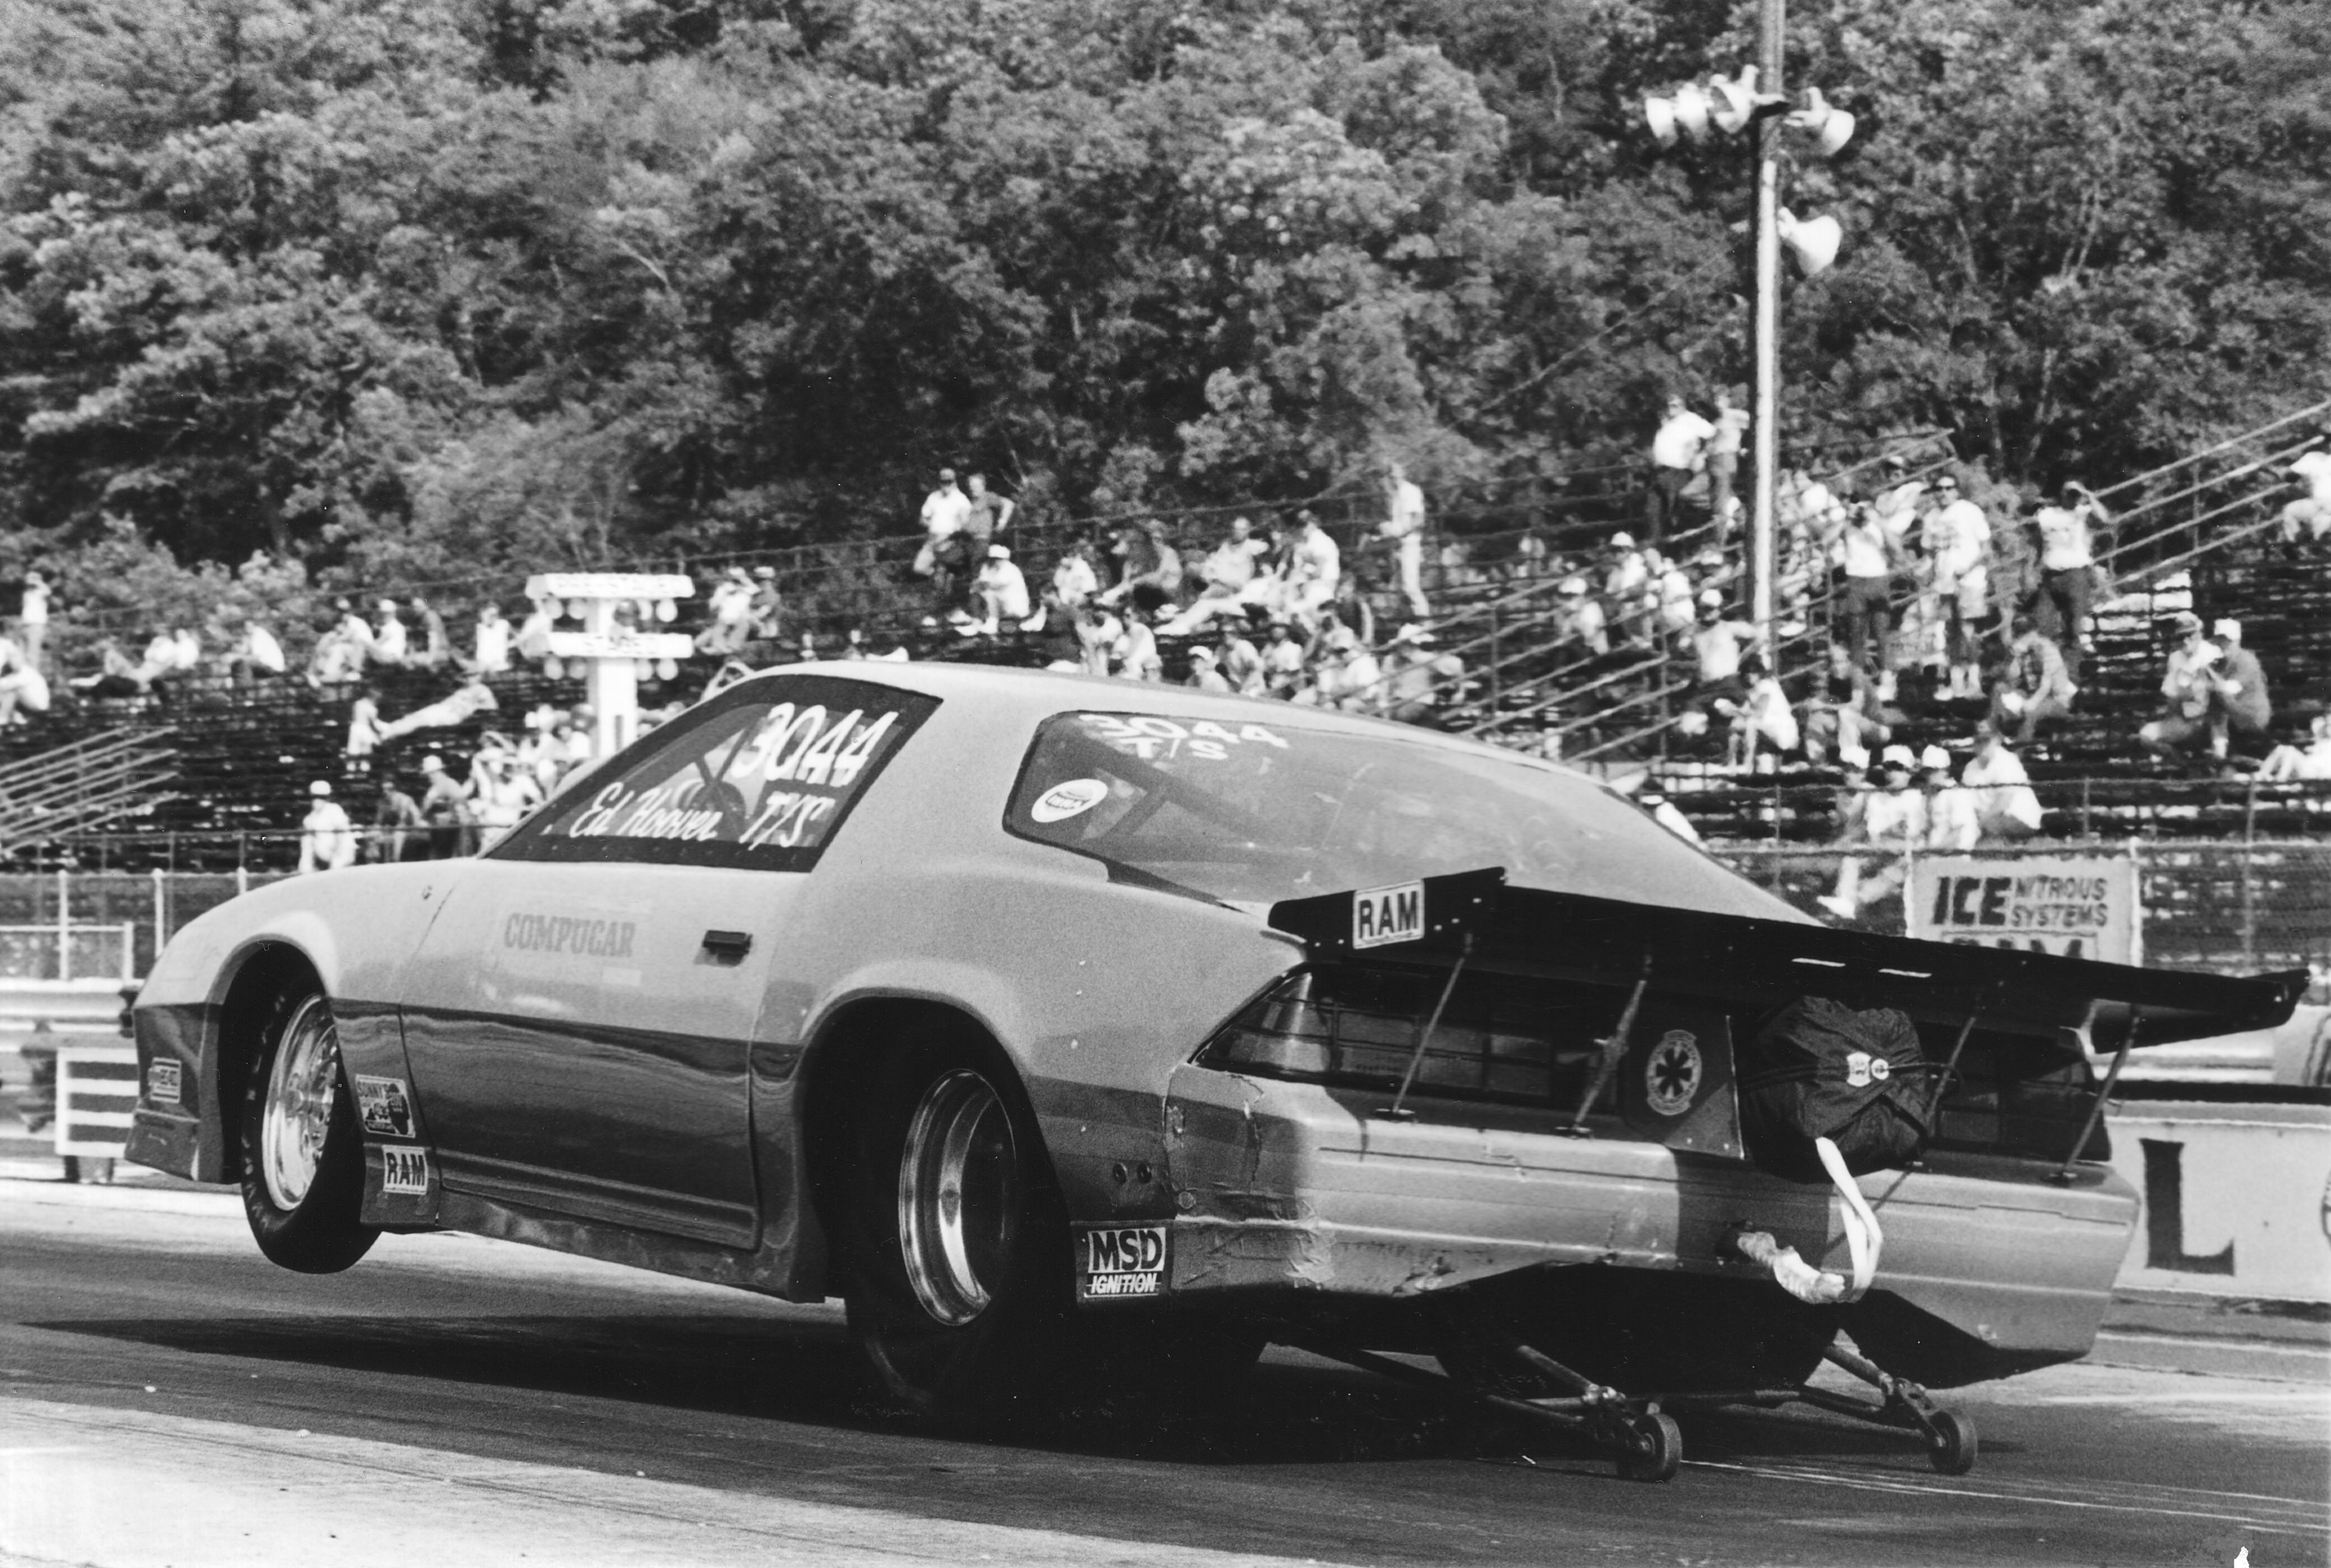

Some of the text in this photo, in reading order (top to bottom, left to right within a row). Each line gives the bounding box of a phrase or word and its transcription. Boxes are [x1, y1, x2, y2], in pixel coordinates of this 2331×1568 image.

[730, 702, 899, 787] 3044
[1078, 714, 1289, 749] 3044
[569, 781, 724, 841] Ed Hoover
[1932, 876, 2011, 925] ICE
[2015, 874, 2108, 901] NITROUS
[1358, 891, 1419, 939] RAM
[2011, 902, 2108, 927] SYSTEMS
[386, 1152, 425, 1186] RAM
[1091, 1230, 1162, 1271] MSD
[1091, 1273, 1157, 1294] IGNITION
